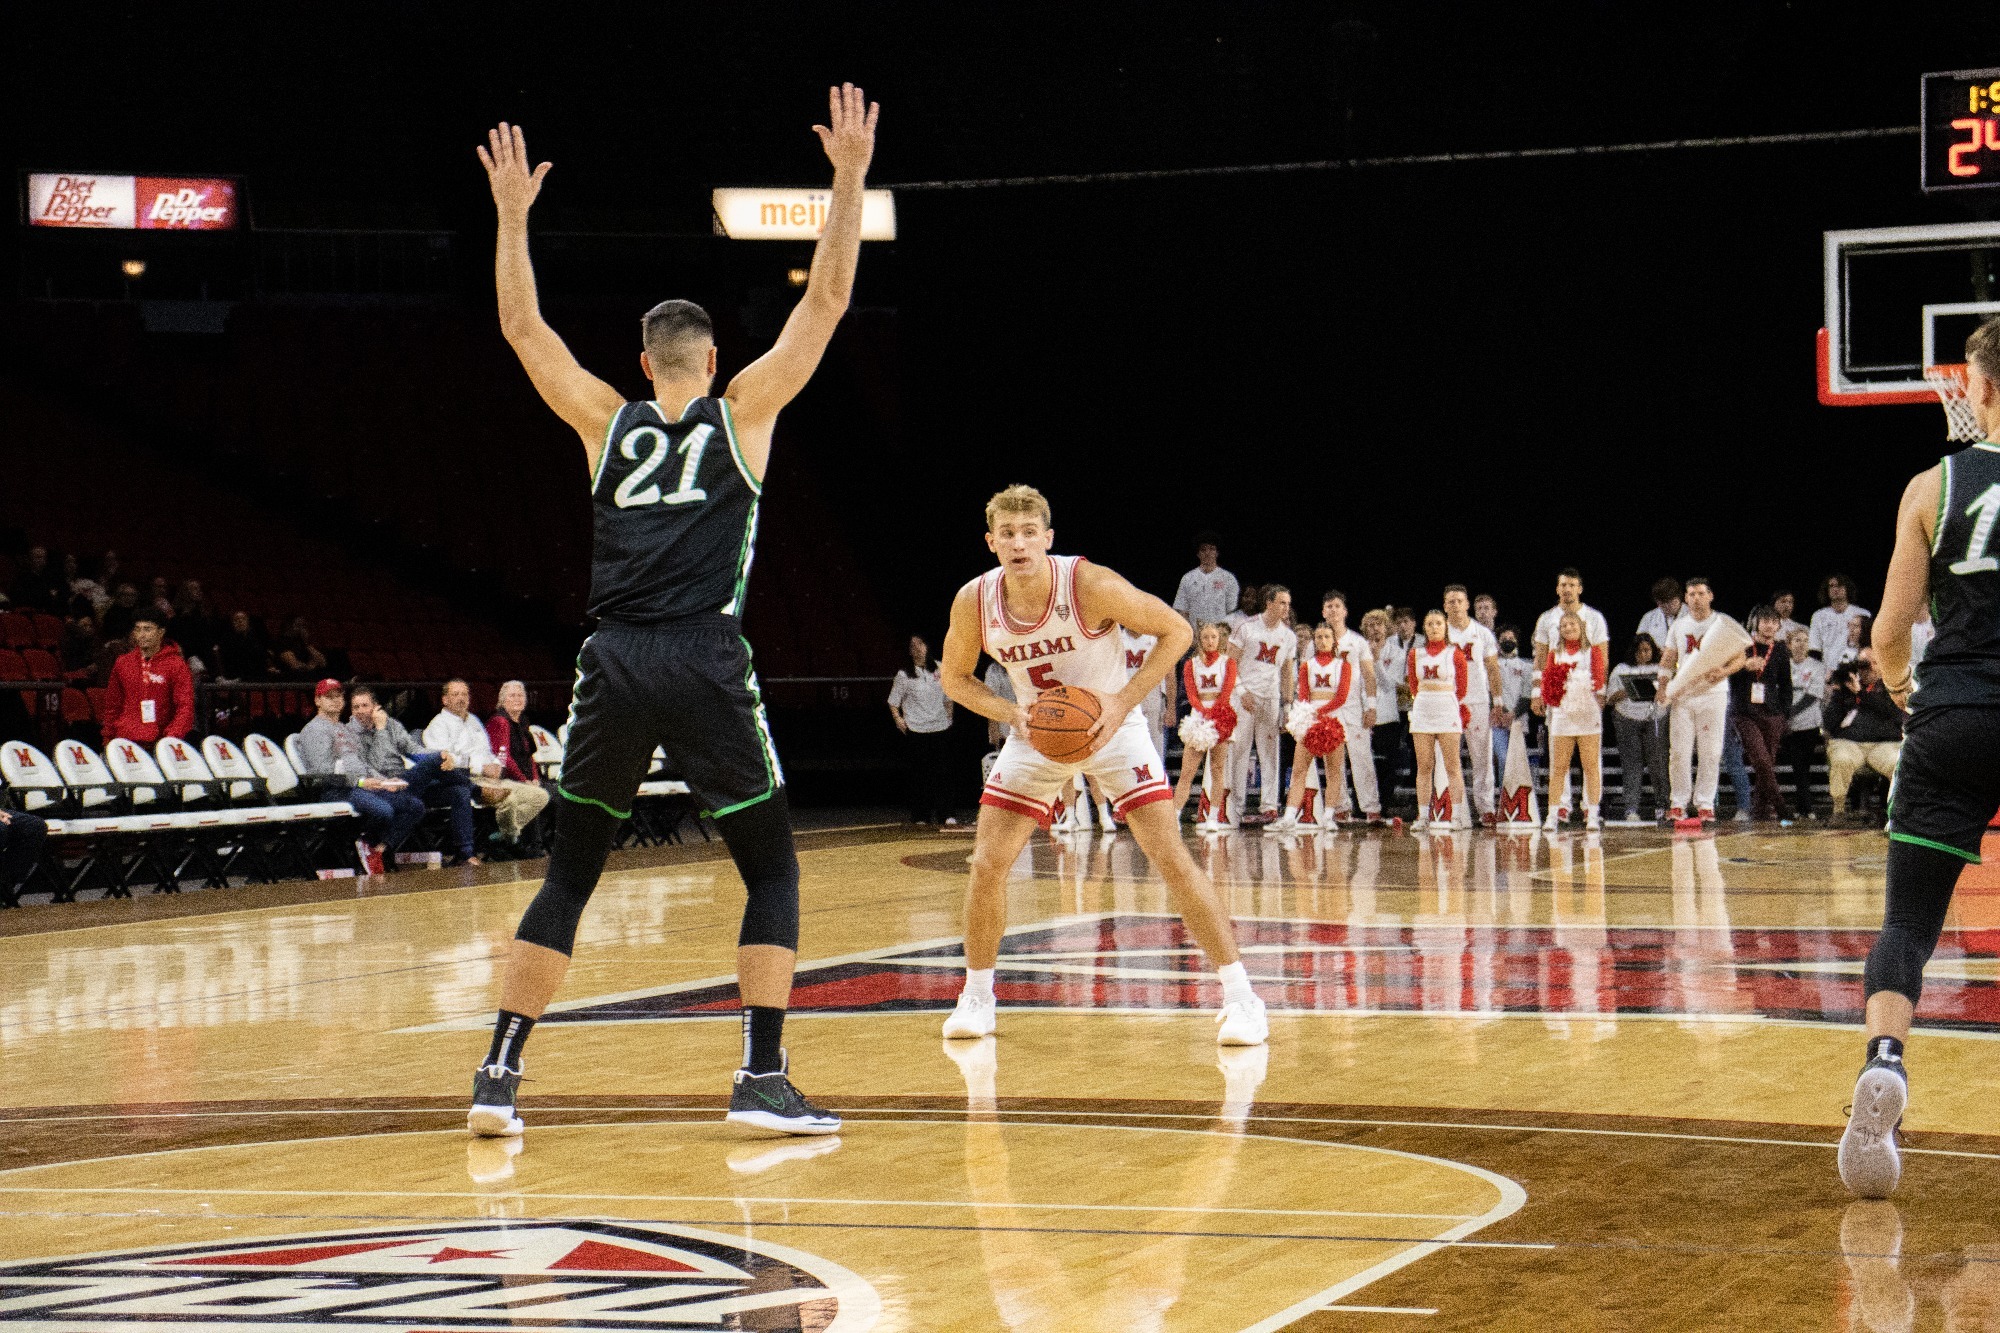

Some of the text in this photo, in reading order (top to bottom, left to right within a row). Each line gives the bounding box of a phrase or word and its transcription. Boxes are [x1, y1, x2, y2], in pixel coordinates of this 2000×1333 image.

[55, 177, 95, 193] Diet
[68, 192, 91, 206] Dr
[177, 188, 206, 208] Dr
[42, 193, 117, 223] Pepper
[149, 193, 227, 225] Pepper
[760, 194, 826, 235] meij
[614, 422, 716, 509] 21
[1950, 483, 2000, 575] 1
[997, 636, 1076, 663] MIAMI
[1256, 641, 1281, 665] M
[1125, 650, 1147, 669] M
[1027, 663, 1063, 698] 5
[1200, 674, 1218, 689] M
[1315, 674, 1332, 688] M
[1423, 665, 1440, 680] M
[14, 748, 36, 767] M
[69, 746, 89, 765] M
[118, 745, 139, 763] M
[169, 743, 189, 762] M
[214, 742, 233, 760] M
[255, 740, 273, 758] M
[1132, 764, 1154, 783] M
[1497, 786, 1533, 823] M
